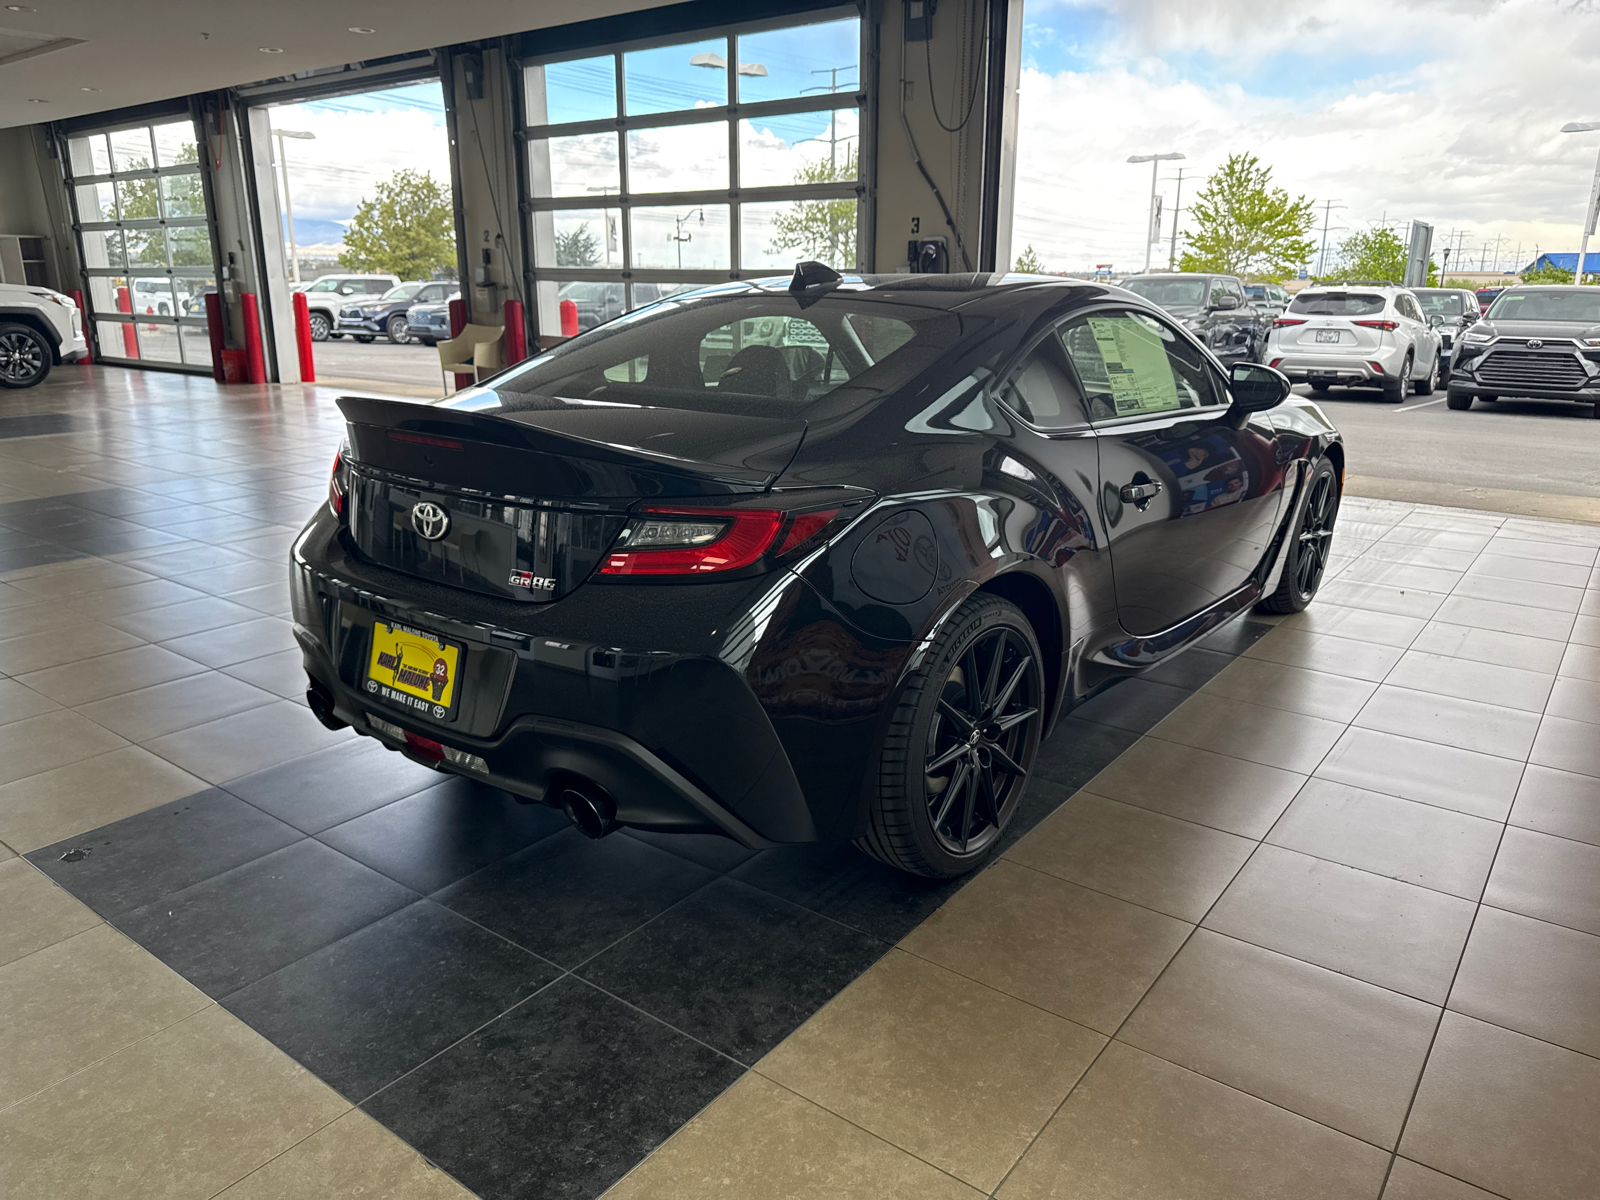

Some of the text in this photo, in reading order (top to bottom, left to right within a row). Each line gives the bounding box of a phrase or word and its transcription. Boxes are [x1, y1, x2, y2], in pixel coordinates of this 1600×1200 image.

[911, 216, 920, 234] 3
[483, 229, 490, 242] 2
[391, 622, 403, 632] KARL
[422, 631, 439, 643] TOYOTA
[946, 616, 982, 660] MICHELIN
[377, 651, 397, 670] KARL
[435, 663, 445, 676] 32
[397, 668, 431, 691] MALONE
[381, 686, 430, 712] WE MAKE IT EASY
